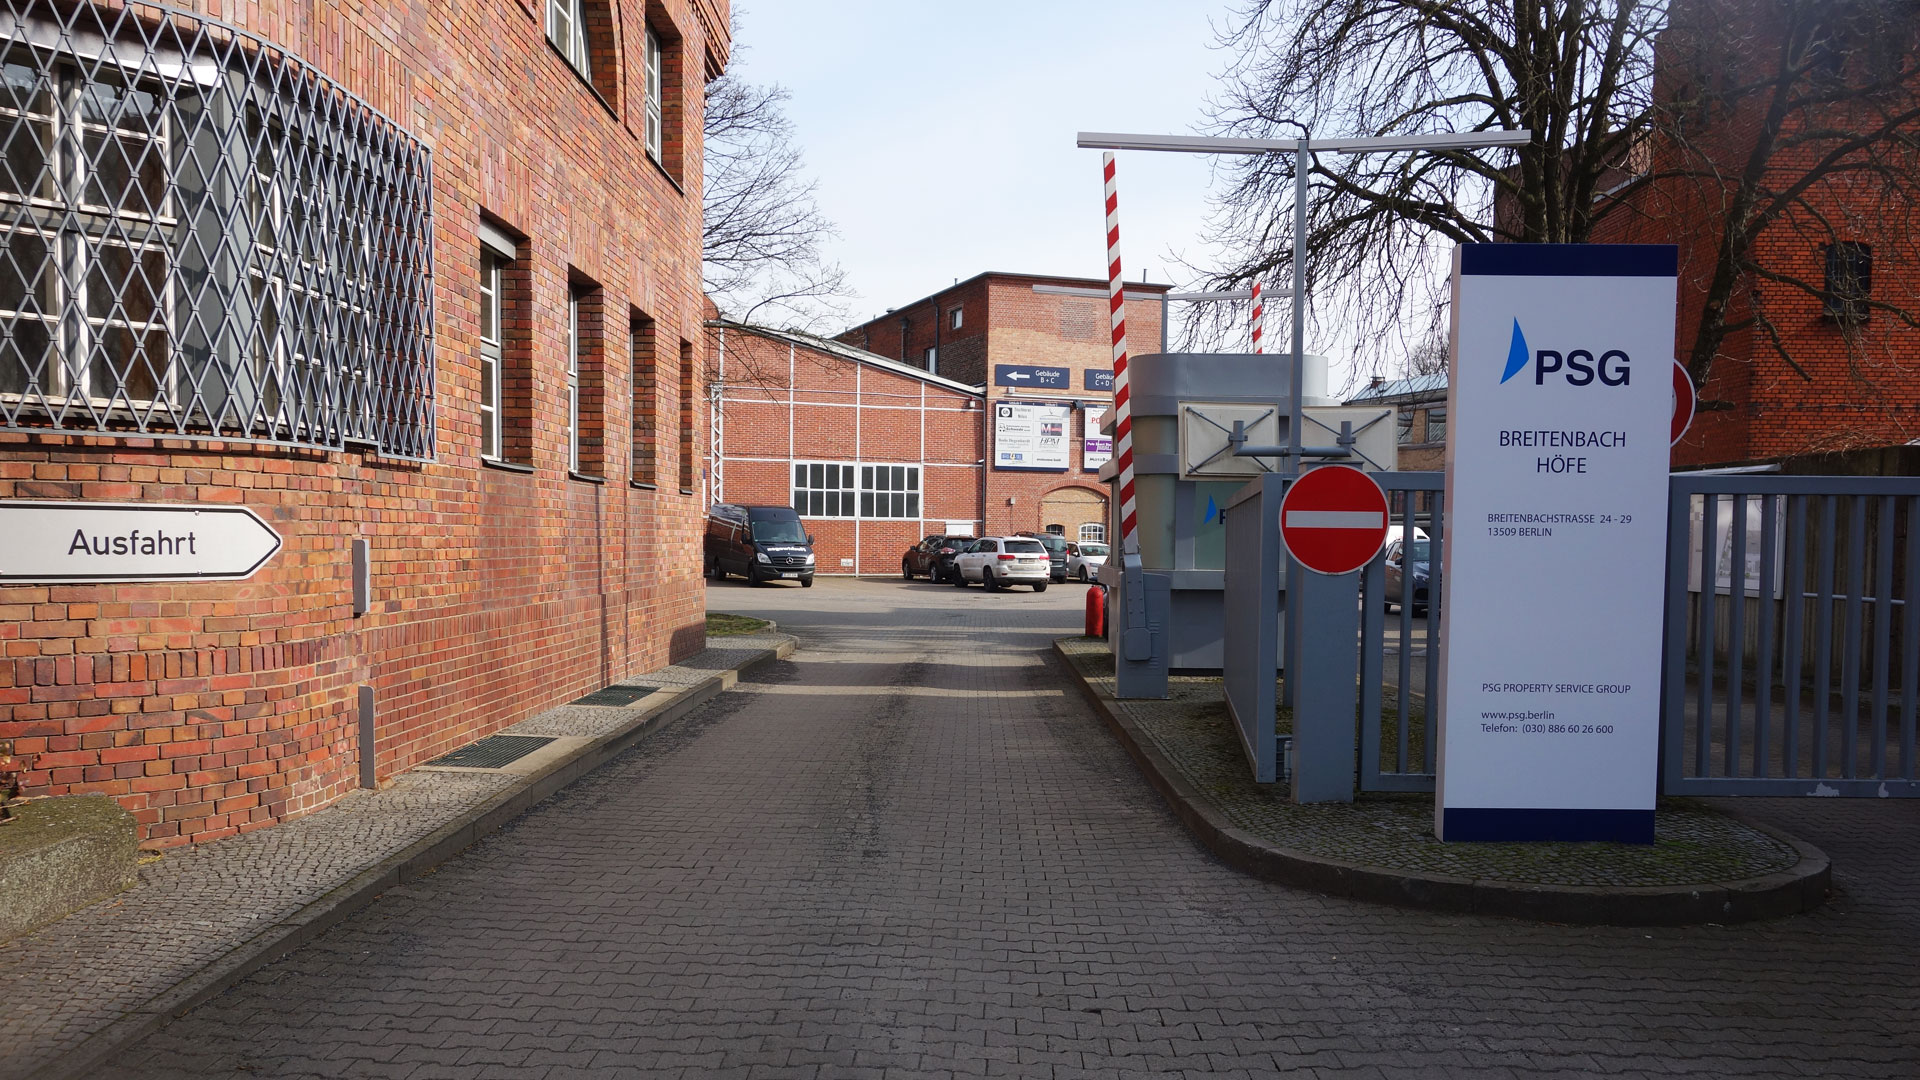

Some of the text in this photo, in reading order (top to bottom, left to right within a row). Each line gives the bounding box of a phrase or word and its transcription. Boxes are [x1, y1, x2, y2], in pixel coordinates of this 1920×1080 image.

[1535, 349, 1631, 387] PSG
[1035, 370, 1060, 378] Gebäude
[1499, 430, 1626, 447] BREITENBACH
[1537, 454, 1587, 473] HÖFE
[1487, 513, 1595, 524] BREITENBACHSTRASSE
[1599, 514, 1612, 524] 24
[1620, 514, 1632, 524] 29
[1487, 527, 1552, 537] 13509 BERLIN
[67, 528, 196, 556] Ausfahrt
[1482, 683, 1631, 694] PSG PROPERTY SERVICE GROUP
[1481, 710, 1555, 721] www.psg.berlin
[1481, 723, 1614, 734] Telefon: (030) 886 60 26 600
